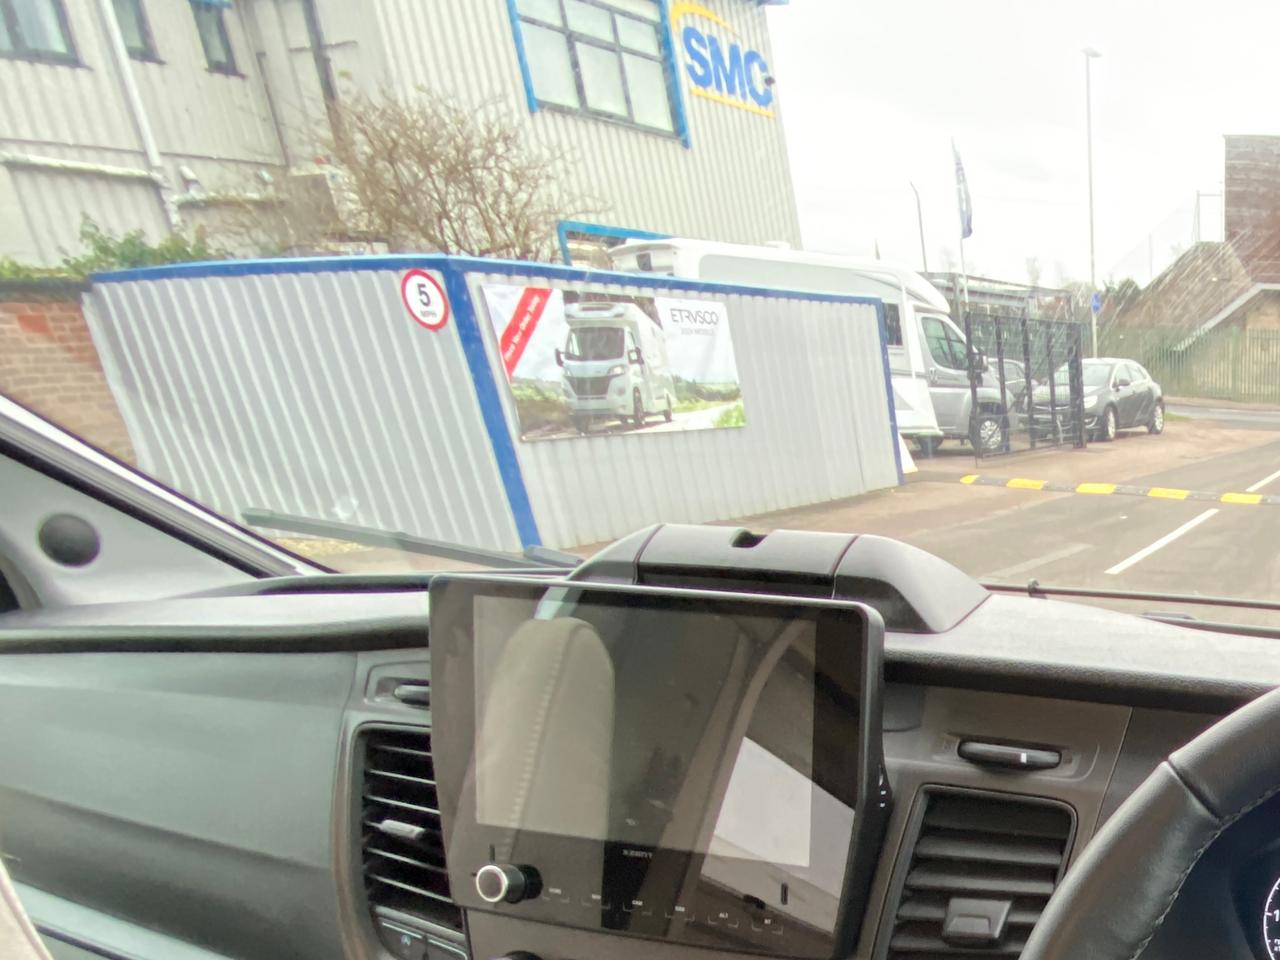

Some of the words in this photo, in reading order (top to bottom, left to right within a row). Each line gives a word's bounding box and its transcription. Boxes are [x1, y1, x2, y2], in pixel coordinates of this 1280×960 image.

[682, 26, 773, 108] SMC
[417, 283, 432, 307] 5
[1273, 909, 1280, 922] 1
